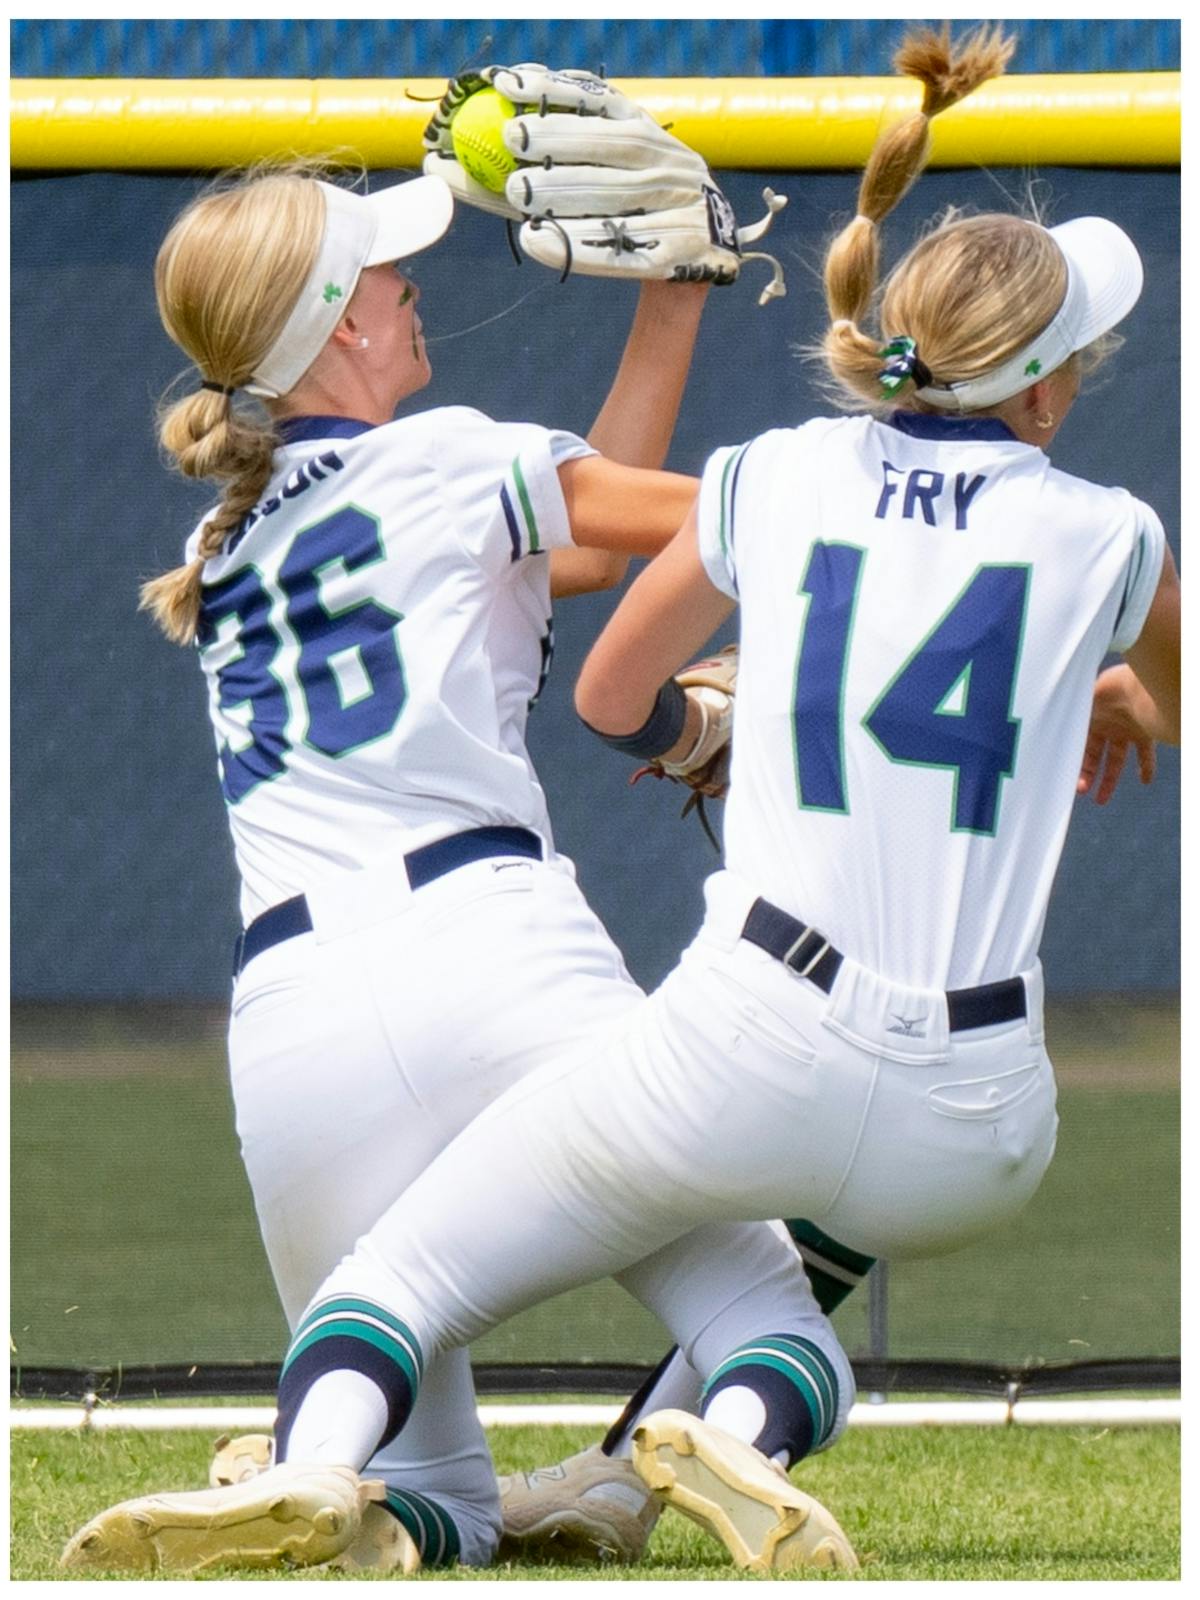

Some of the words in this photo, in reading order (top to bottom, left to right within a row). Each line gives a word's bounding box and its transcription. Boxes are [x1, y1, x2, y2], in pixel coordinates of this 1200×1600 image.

[875, 460, 987, 530] FRY
[198, 501, 410, 805] 36
[790, 537, 1033, 838] 14
